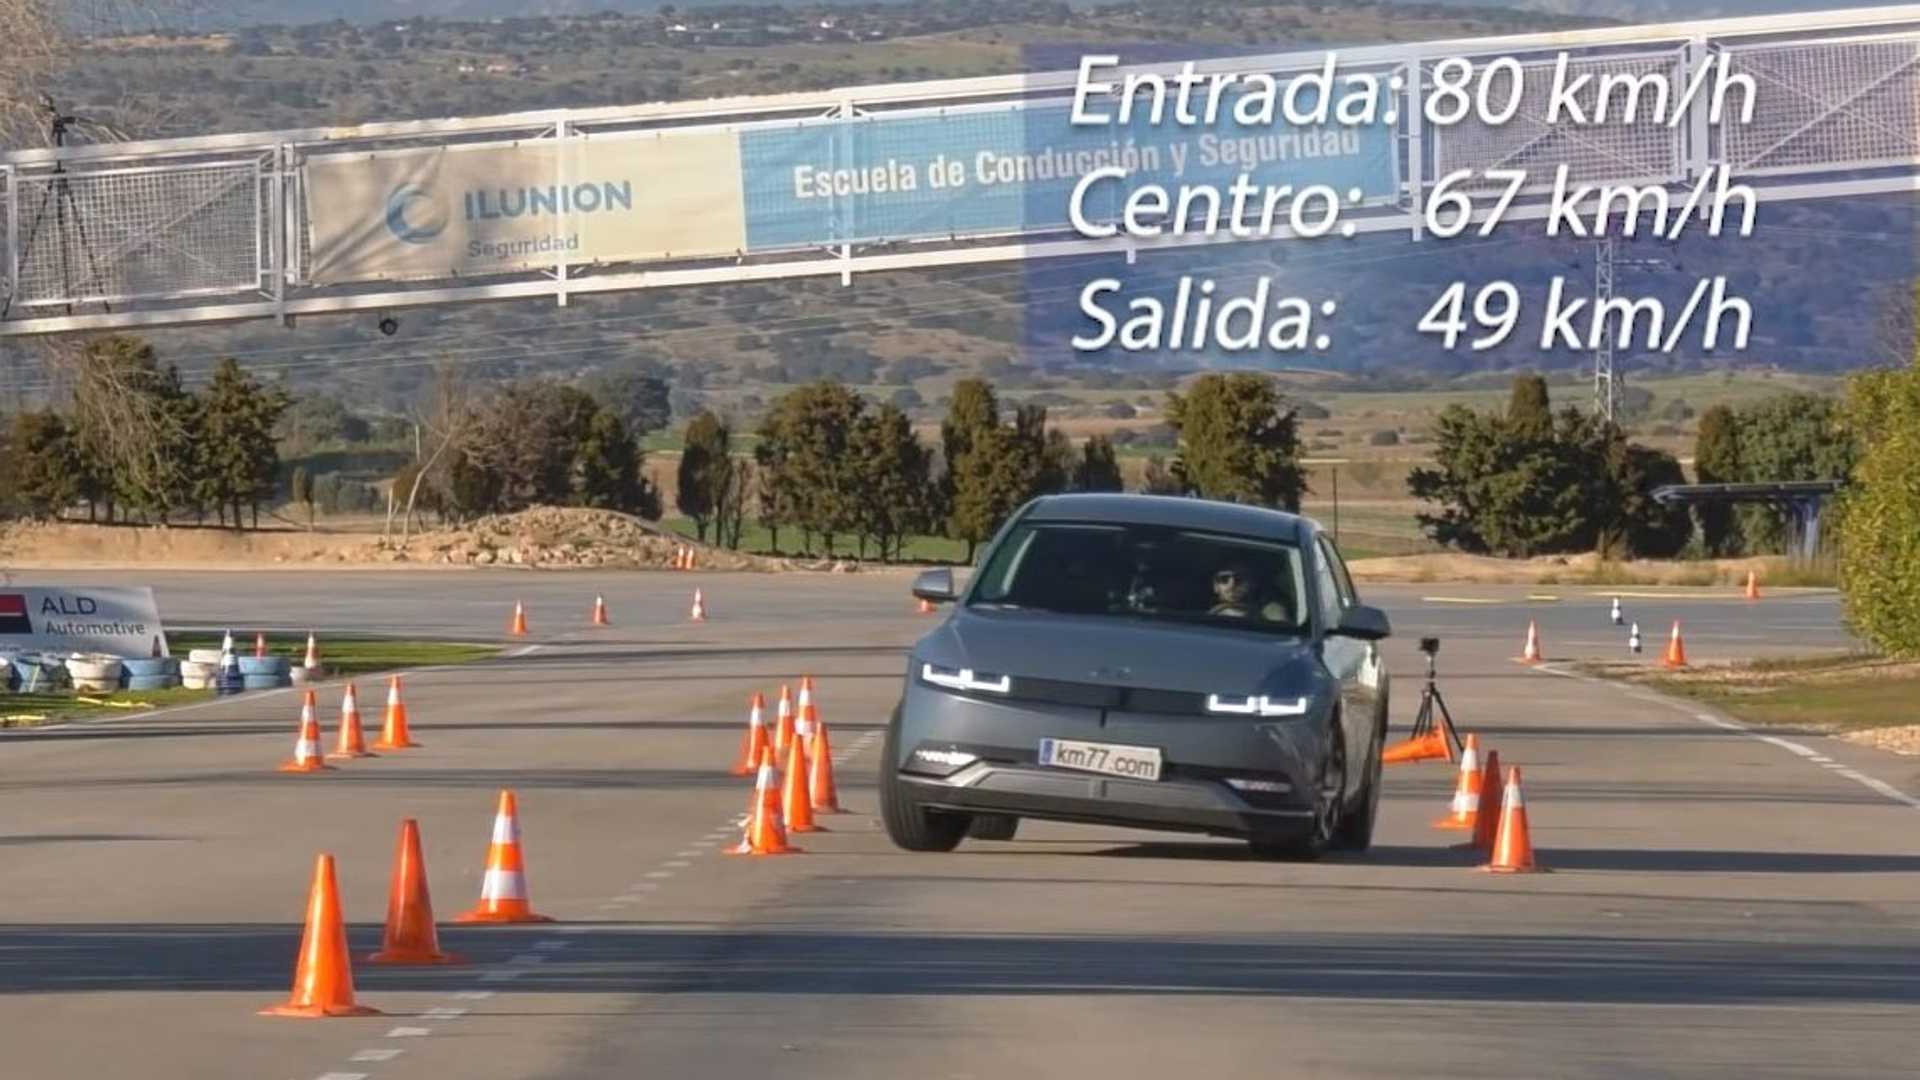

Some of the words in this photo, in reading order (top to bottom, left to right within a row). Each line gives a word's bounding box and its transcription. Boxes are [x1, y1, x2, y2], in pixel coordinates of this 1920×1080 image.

[794, 159, 917, 198] Escuela
[928, 155, 965, 187] de
[975, 139, 1160, 185] Conducción
[1170, 141, 1187, 176] y
[1199, 126, 1361, 170] Seguridad
[464, 181, 632, 220] ILUNION
[468, 233, 579, 260] Seguridad
[41, 596, 97, 615] ALD
[46, 620, 146, 635] Automotive
[1056, 742, 1156, 777] km77.com
